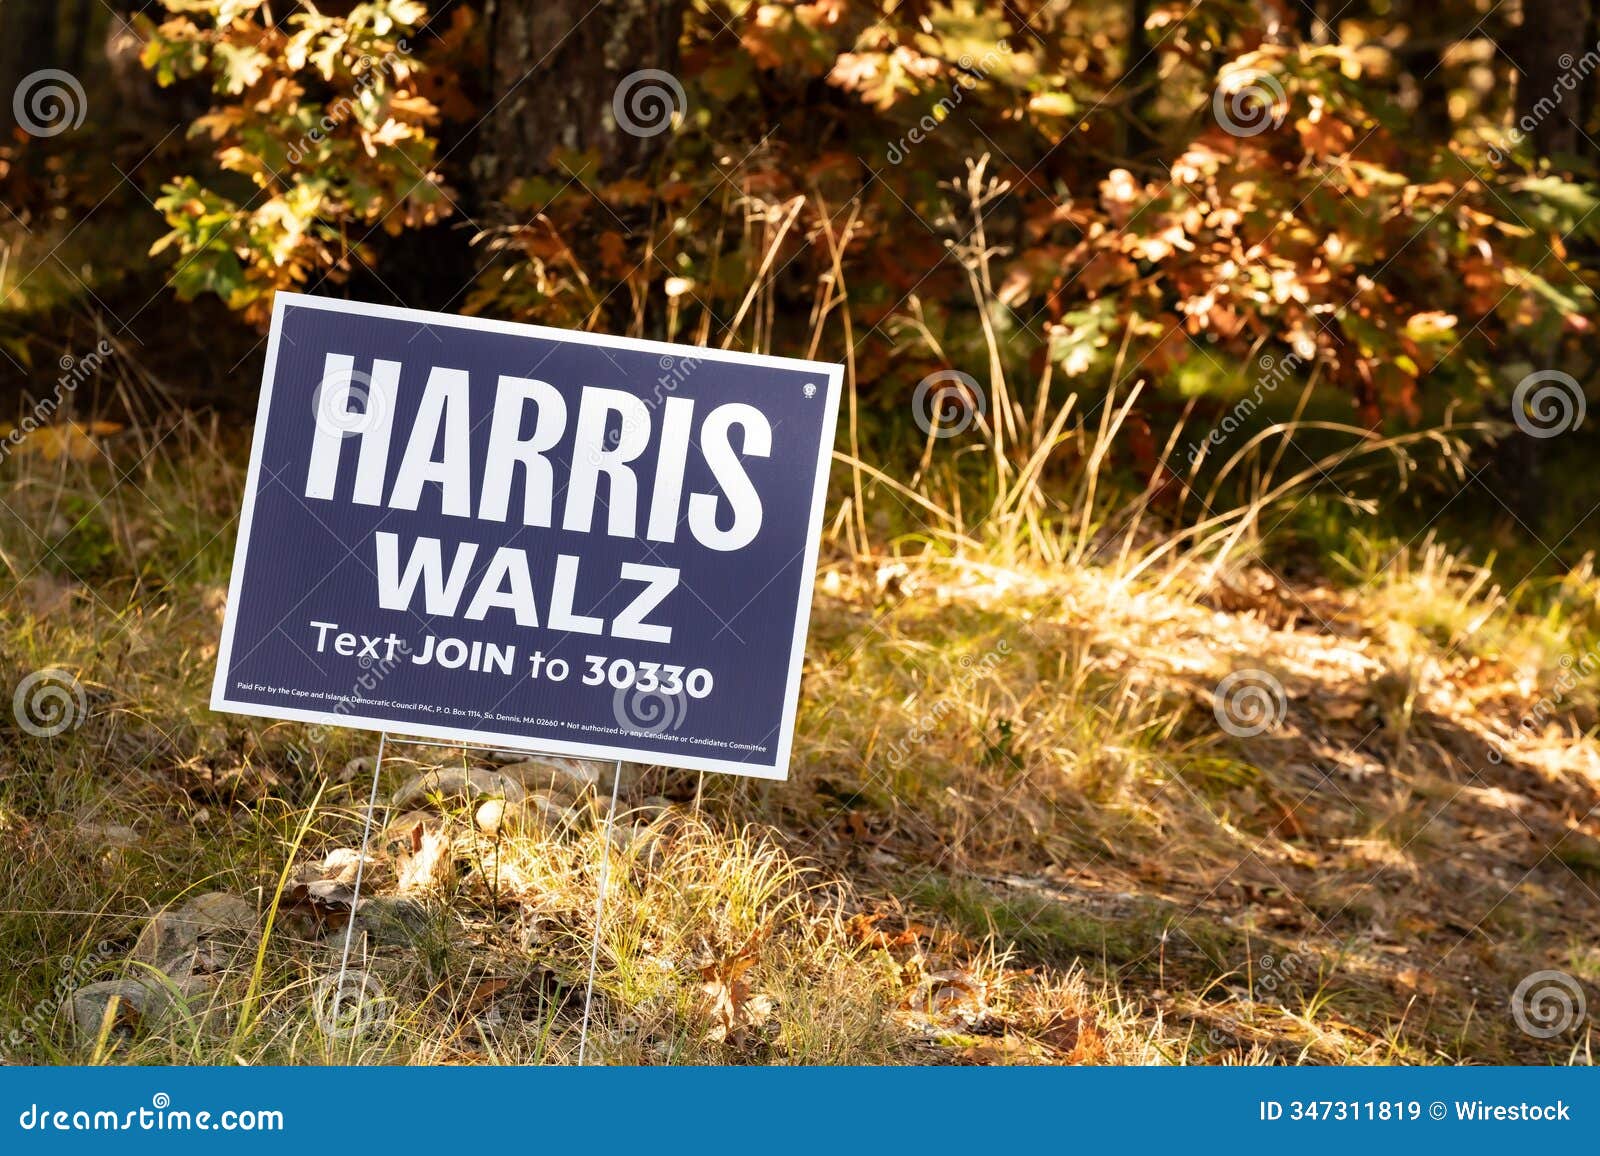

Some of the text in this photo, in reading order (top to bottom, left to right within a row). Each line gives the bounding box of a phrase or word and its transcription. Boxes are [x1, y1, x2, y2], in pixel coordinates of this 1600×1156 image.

[305, 352, 772, 552] HARRIS
[375, 530, 681, 644] WALZ
[310, 621, 714, 699] Text JOIN to 30330
[237, 682, 253, 690] Paid
[254, 684, 267, 692] For
[267, 685, 277, 694] by
[278, 687, 290, 695] the
[291, 689, 309, 699] Cape
[310, 691, 324, 699] and
[325, 693, 350, 702] Islands
[351, 696, 390, 707] Democratic
[391, 701, 417, 710] Council
[418, 704, 435, 713] PAC,
[452, 708, 466, 716] Box
[496, 713, 521, 723] Dennis,
[536, 718, 559, 727] 02660
[566, 722, 579, 731] Not
[581, 724, 618, 734] authorized
[619, 727, 629, 737] by
[644, 731, 679, 741] Candidate
[689, 737, 728, 748] Candidates
